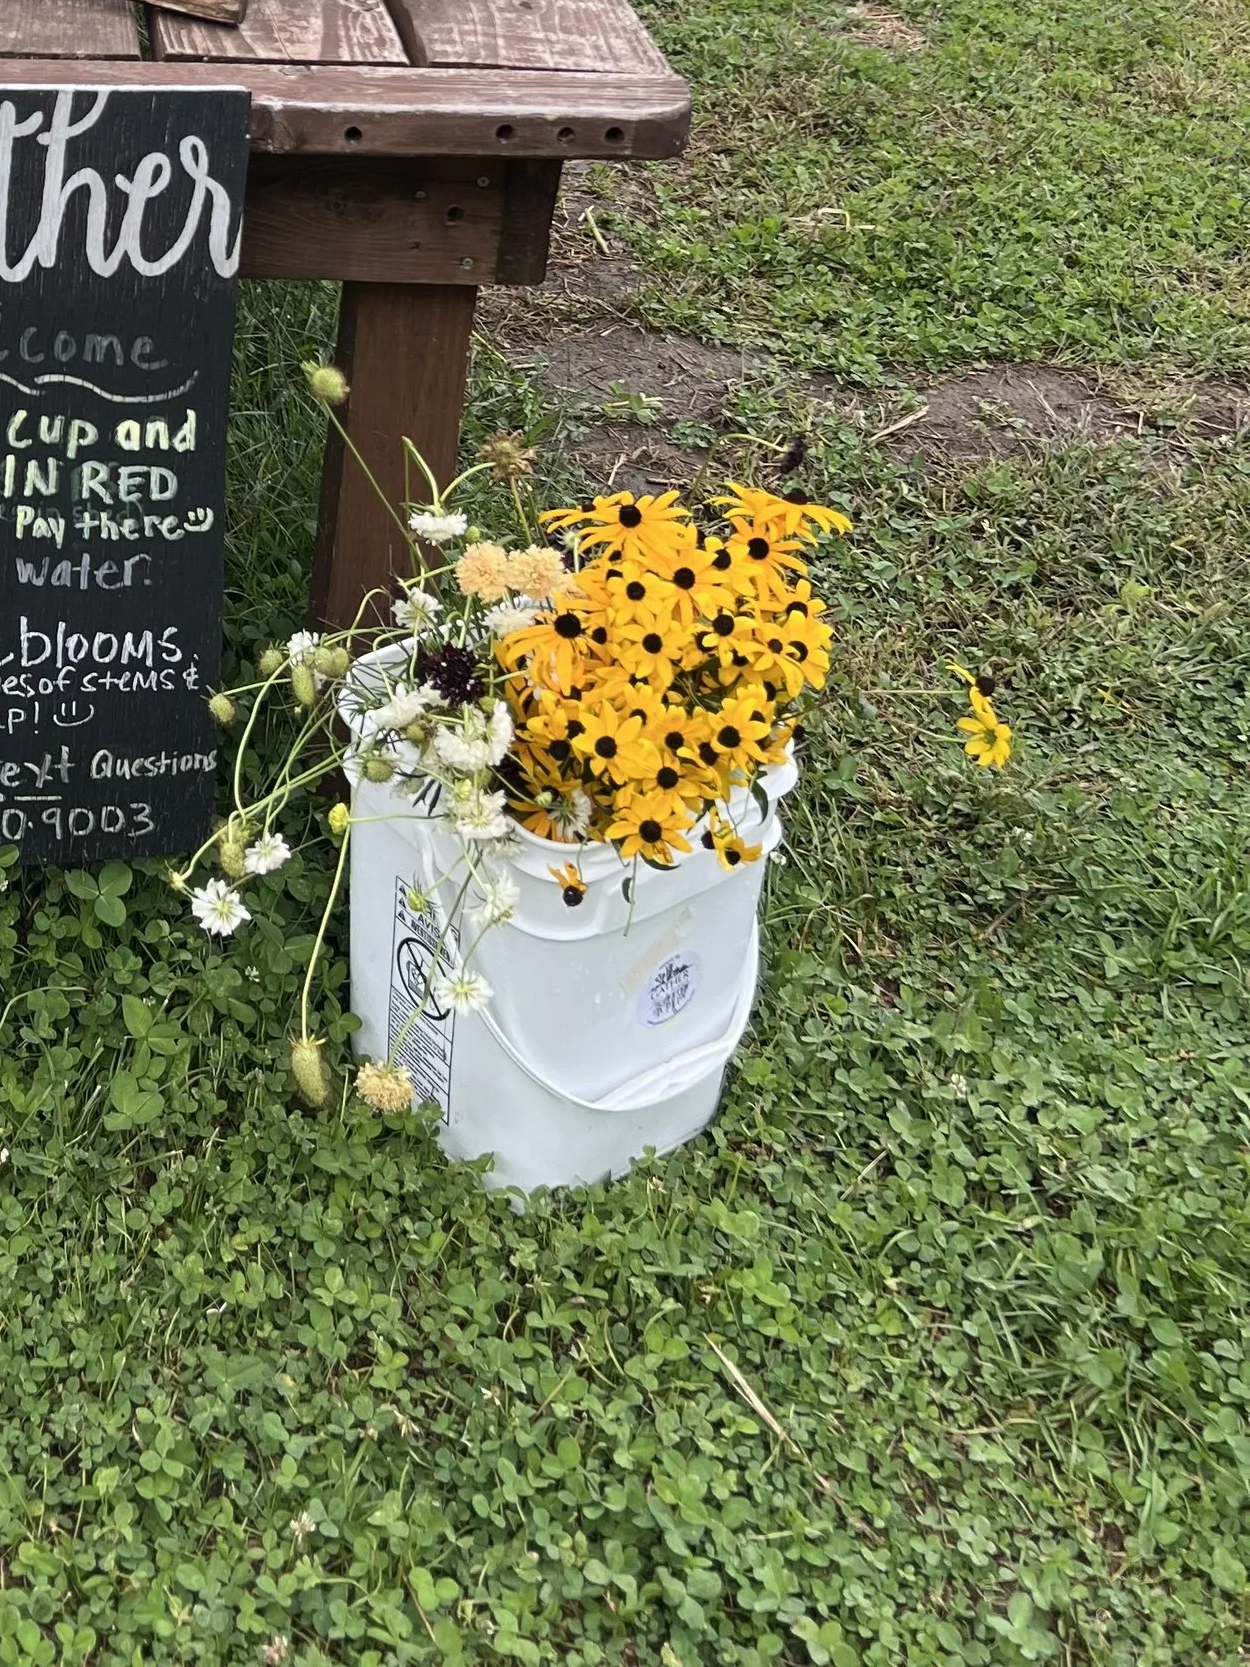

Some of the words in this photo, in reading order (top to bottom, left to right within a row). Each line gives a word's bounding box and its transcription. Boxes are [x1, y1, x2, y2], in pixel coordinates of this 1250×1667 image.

[115, 408, 197, 453] and
[3, 454, 64, 499] IN
[80, 460, 179, 505] RED
[74, 511, 186, 542] there
[38, 665, 77, 693] of
[89, 747, 218, 781] Questions
